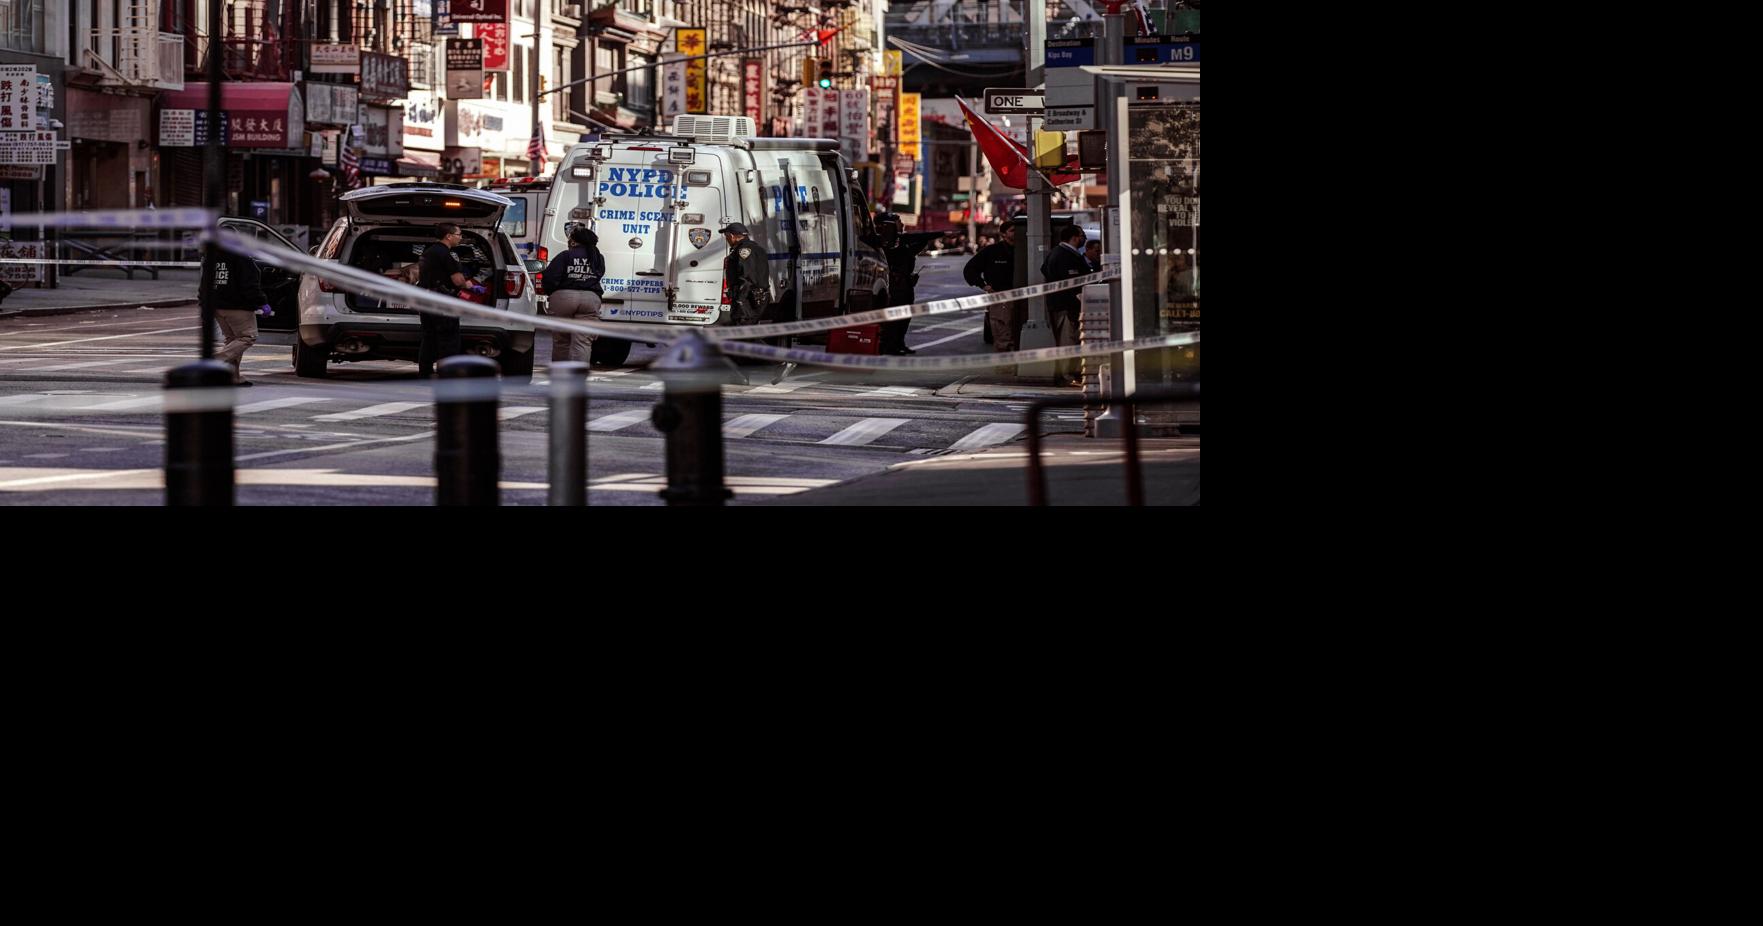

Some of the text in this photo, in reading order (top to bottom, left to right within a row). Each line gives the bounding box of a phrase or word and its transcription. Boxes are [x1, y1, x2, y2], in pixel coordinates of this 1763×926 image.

[1047, 40, 1081, 48] Destination
[1061, 51, 1072, 59] Bay
[1170, 46, 1194, 61] M9
[994, 97, 1023, 107] ONE
[1052, 109, 1080, 117] Broadway
[608, 167, 675, 184] NYPD
[599, 182, 687, 199] POLICE
[599, 209, 636, 221] CRIME
[622, 223, 651, 235] UNIT
[567, 265, 595, 275] POLI
[215, 271, 229, 280] ICE
